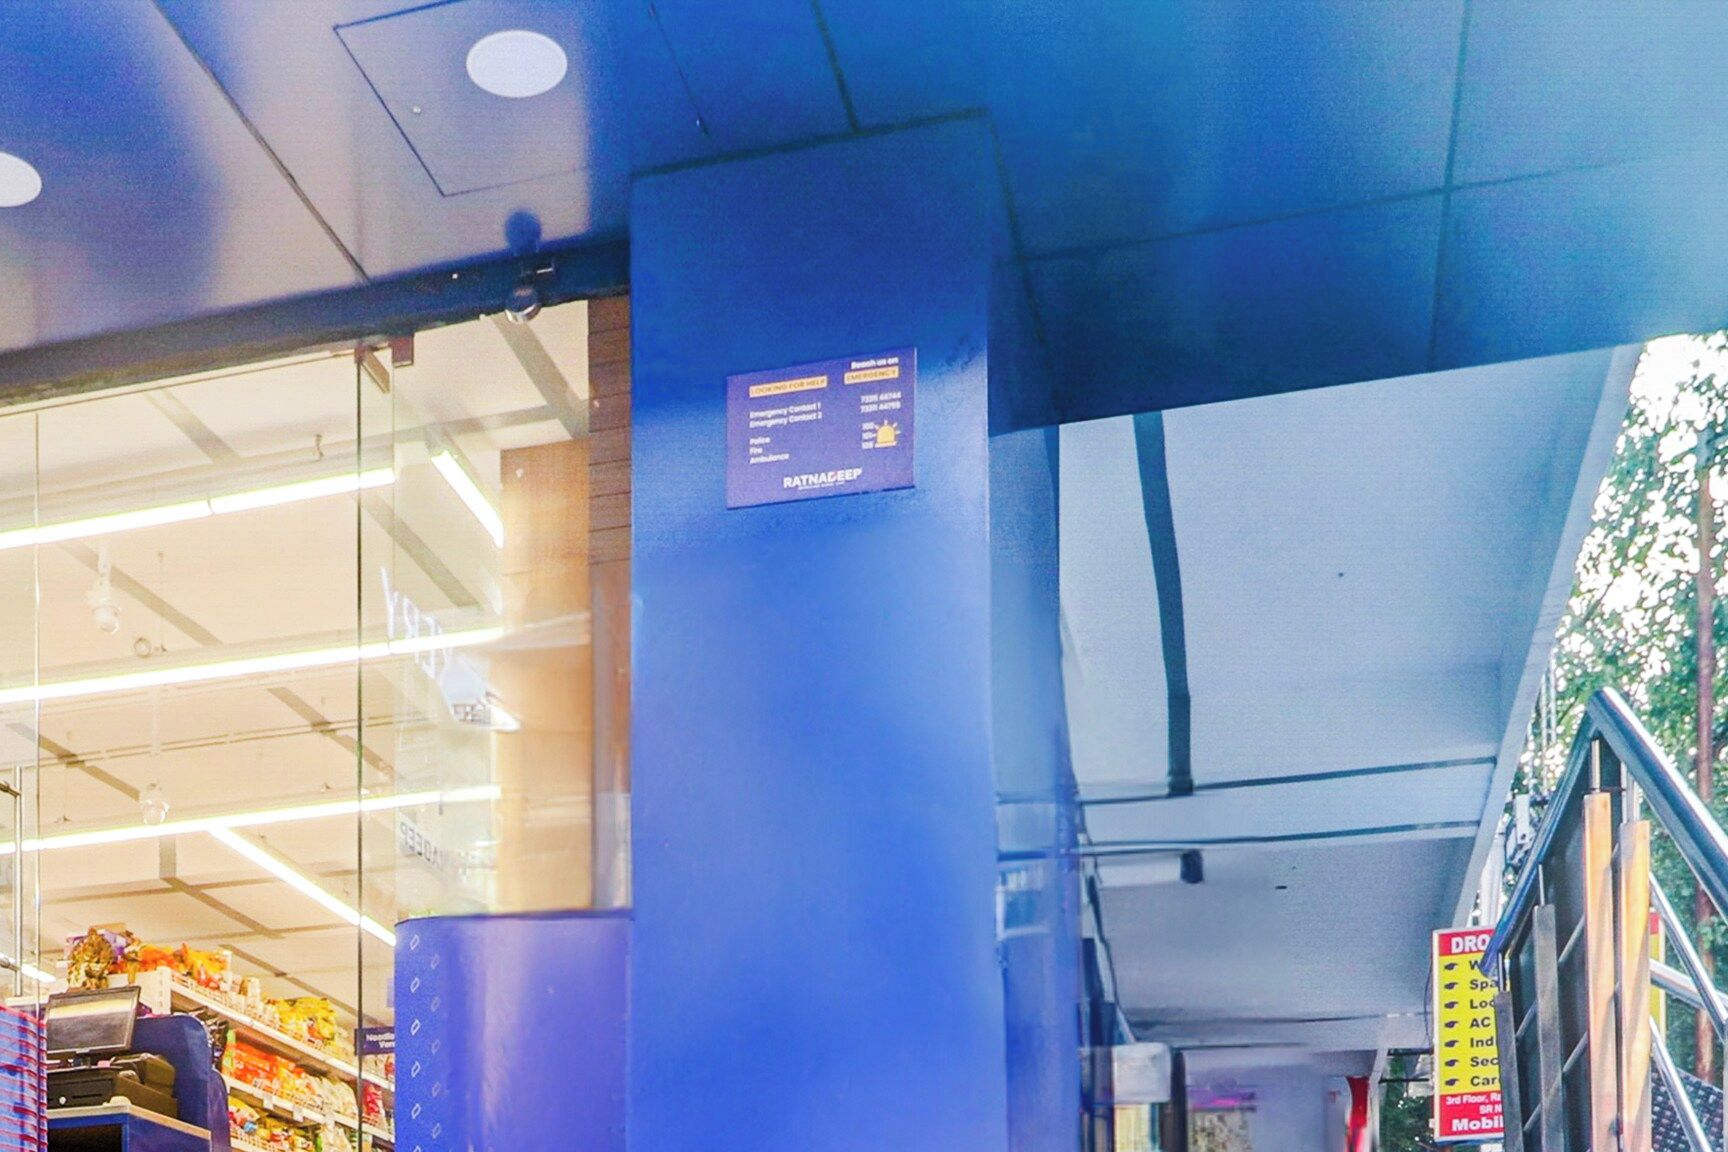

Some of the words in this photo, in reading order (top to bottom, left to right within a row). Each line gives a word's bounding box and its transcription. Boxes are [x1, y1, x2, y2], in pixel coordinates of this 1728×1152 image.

[846, 370, 897, 382] EMERGENCY
[750, 384, 786, 395] LOOKING
[789, 382, 804, 391] FOR
[807, 379, 826, 388] HELP
[749, 408, 787, 418] Emergency
[789, 403, 817, 412] Contact
[749, 417, 787, 428] Emergency
[789, 413, 817, 423] Contact
[749, 453, 789, 465] Ambulance
[783, 467, 863, 489] RATNADEEP
[1469, 1016, 1491, 1028] AC
[1470, 1074, 1501, 1087] Car
[1445, 1095, 1462, 1105] 3rd
[1479, 1104, 1493, 1114] SR
